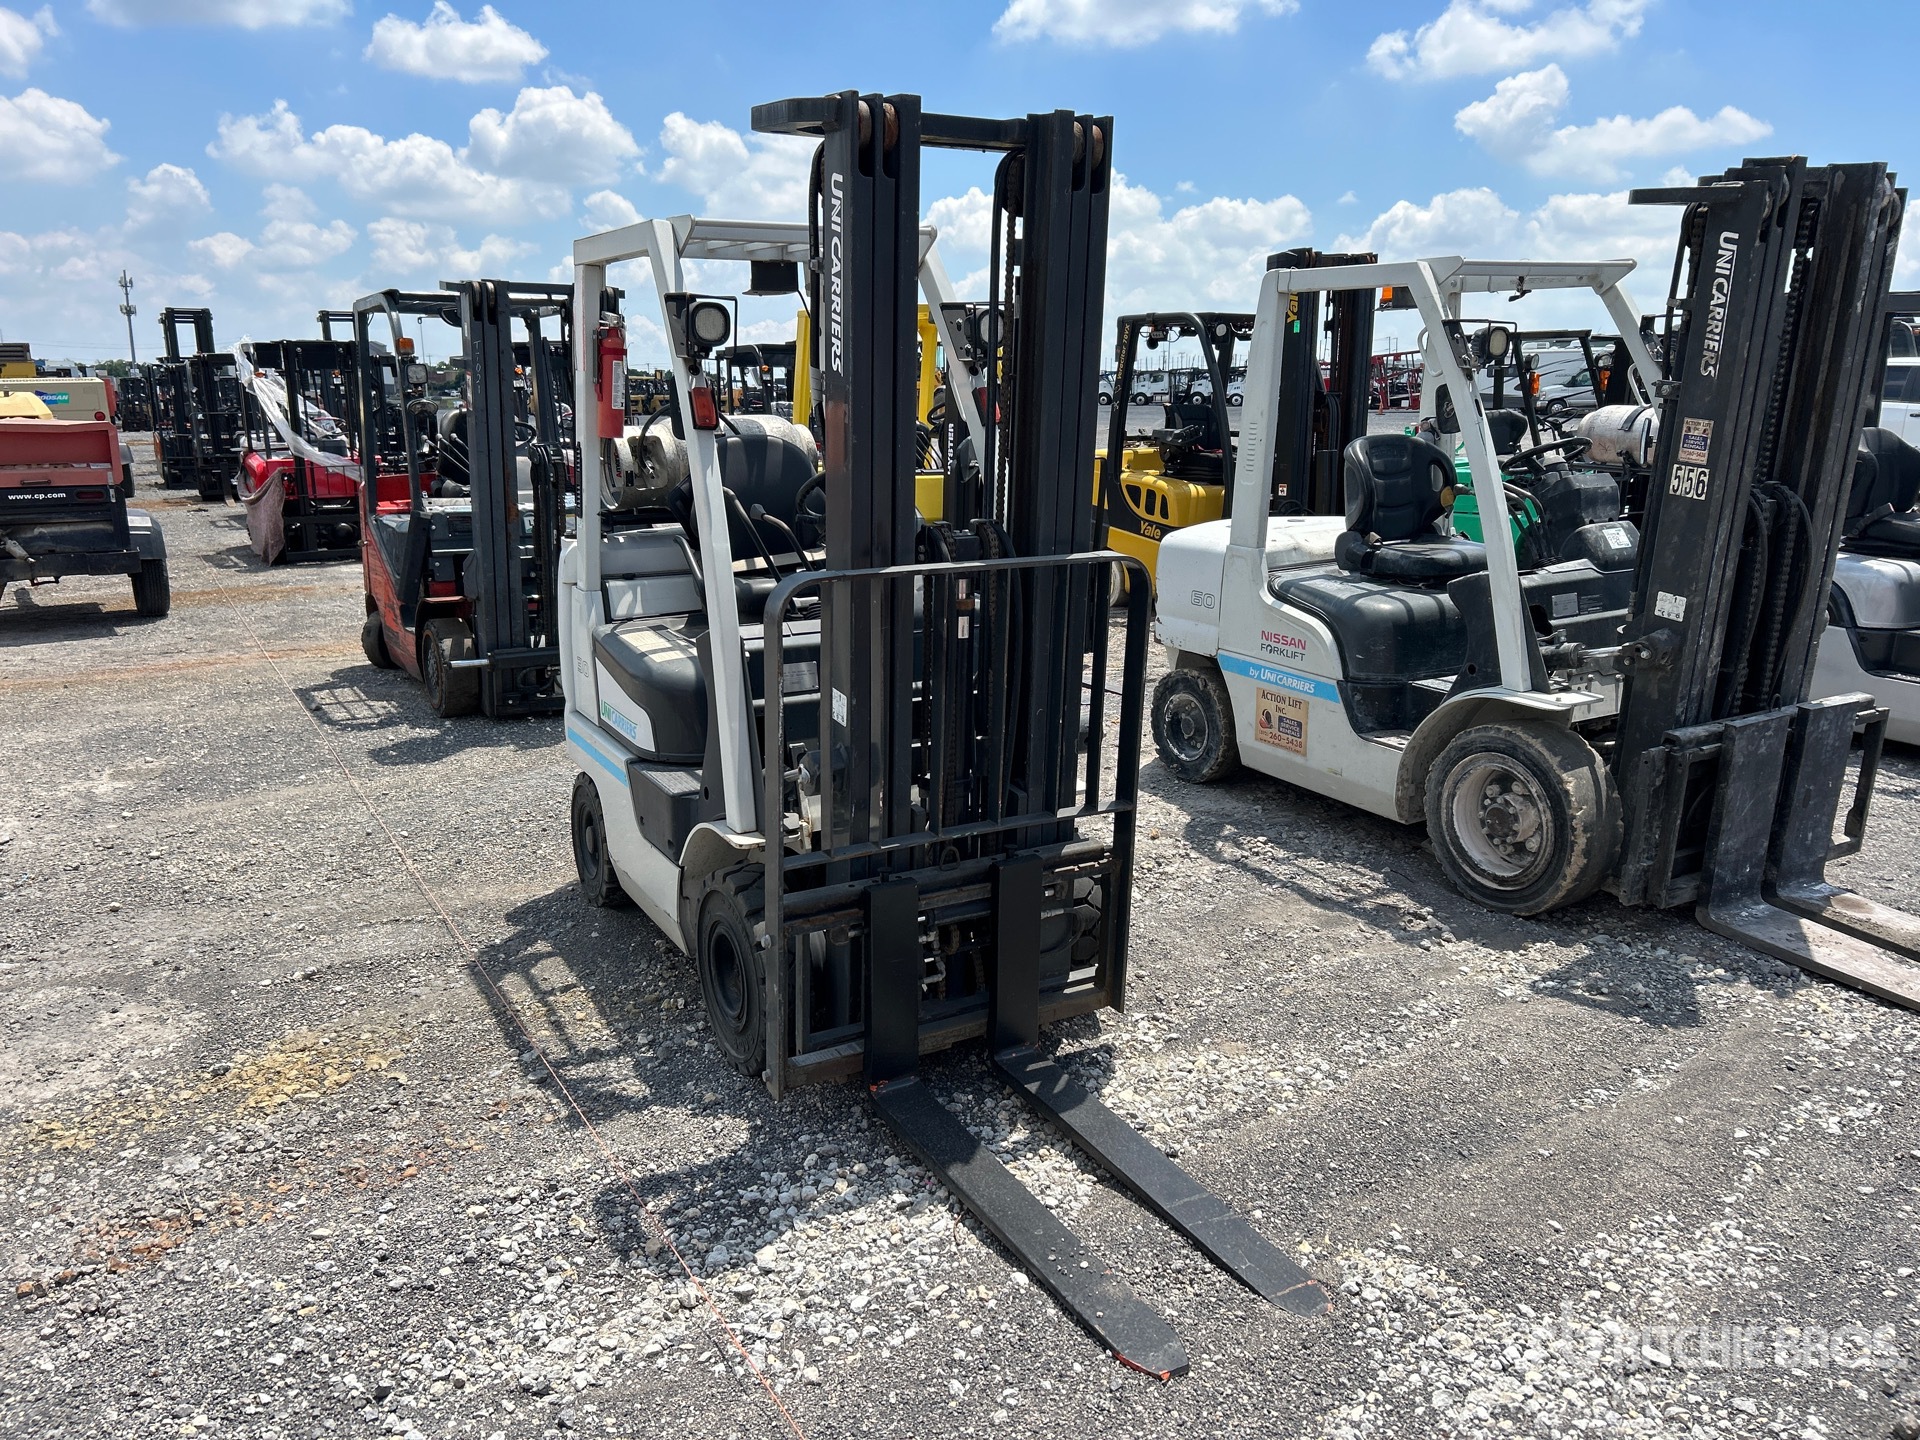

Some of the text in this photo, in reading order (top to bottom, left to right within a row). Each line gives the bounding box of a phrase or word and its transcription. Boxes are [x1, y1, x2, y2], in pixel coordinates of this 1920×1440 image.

[1286, 294, 1298, 323] Yal
[1117, 345, 1127, 380] Veracitor
[1672, 465, 1707, 498] 556
[7, 491, 67, 500] www.cp.com
[1140, 520, 1162, 539] Yale
[1190, 589, 1216, 609] 60
[1261, 630, 1307, 650] NISSAN
[1260, 643, 1306, 661] FORKLIFT
[1249, 666, 1259, 678] by
[1261, 689, 1303, 710] ACTION LIFT
[1275, 705, 1287, 715] INC.
[1280, 722, 1300, 733] SERVICE
[1283, 718, 1298, 727] SALES
[1269, 732, 1303, 748] 260-5438
[1279, 727, 1300, 737] RENTALS
